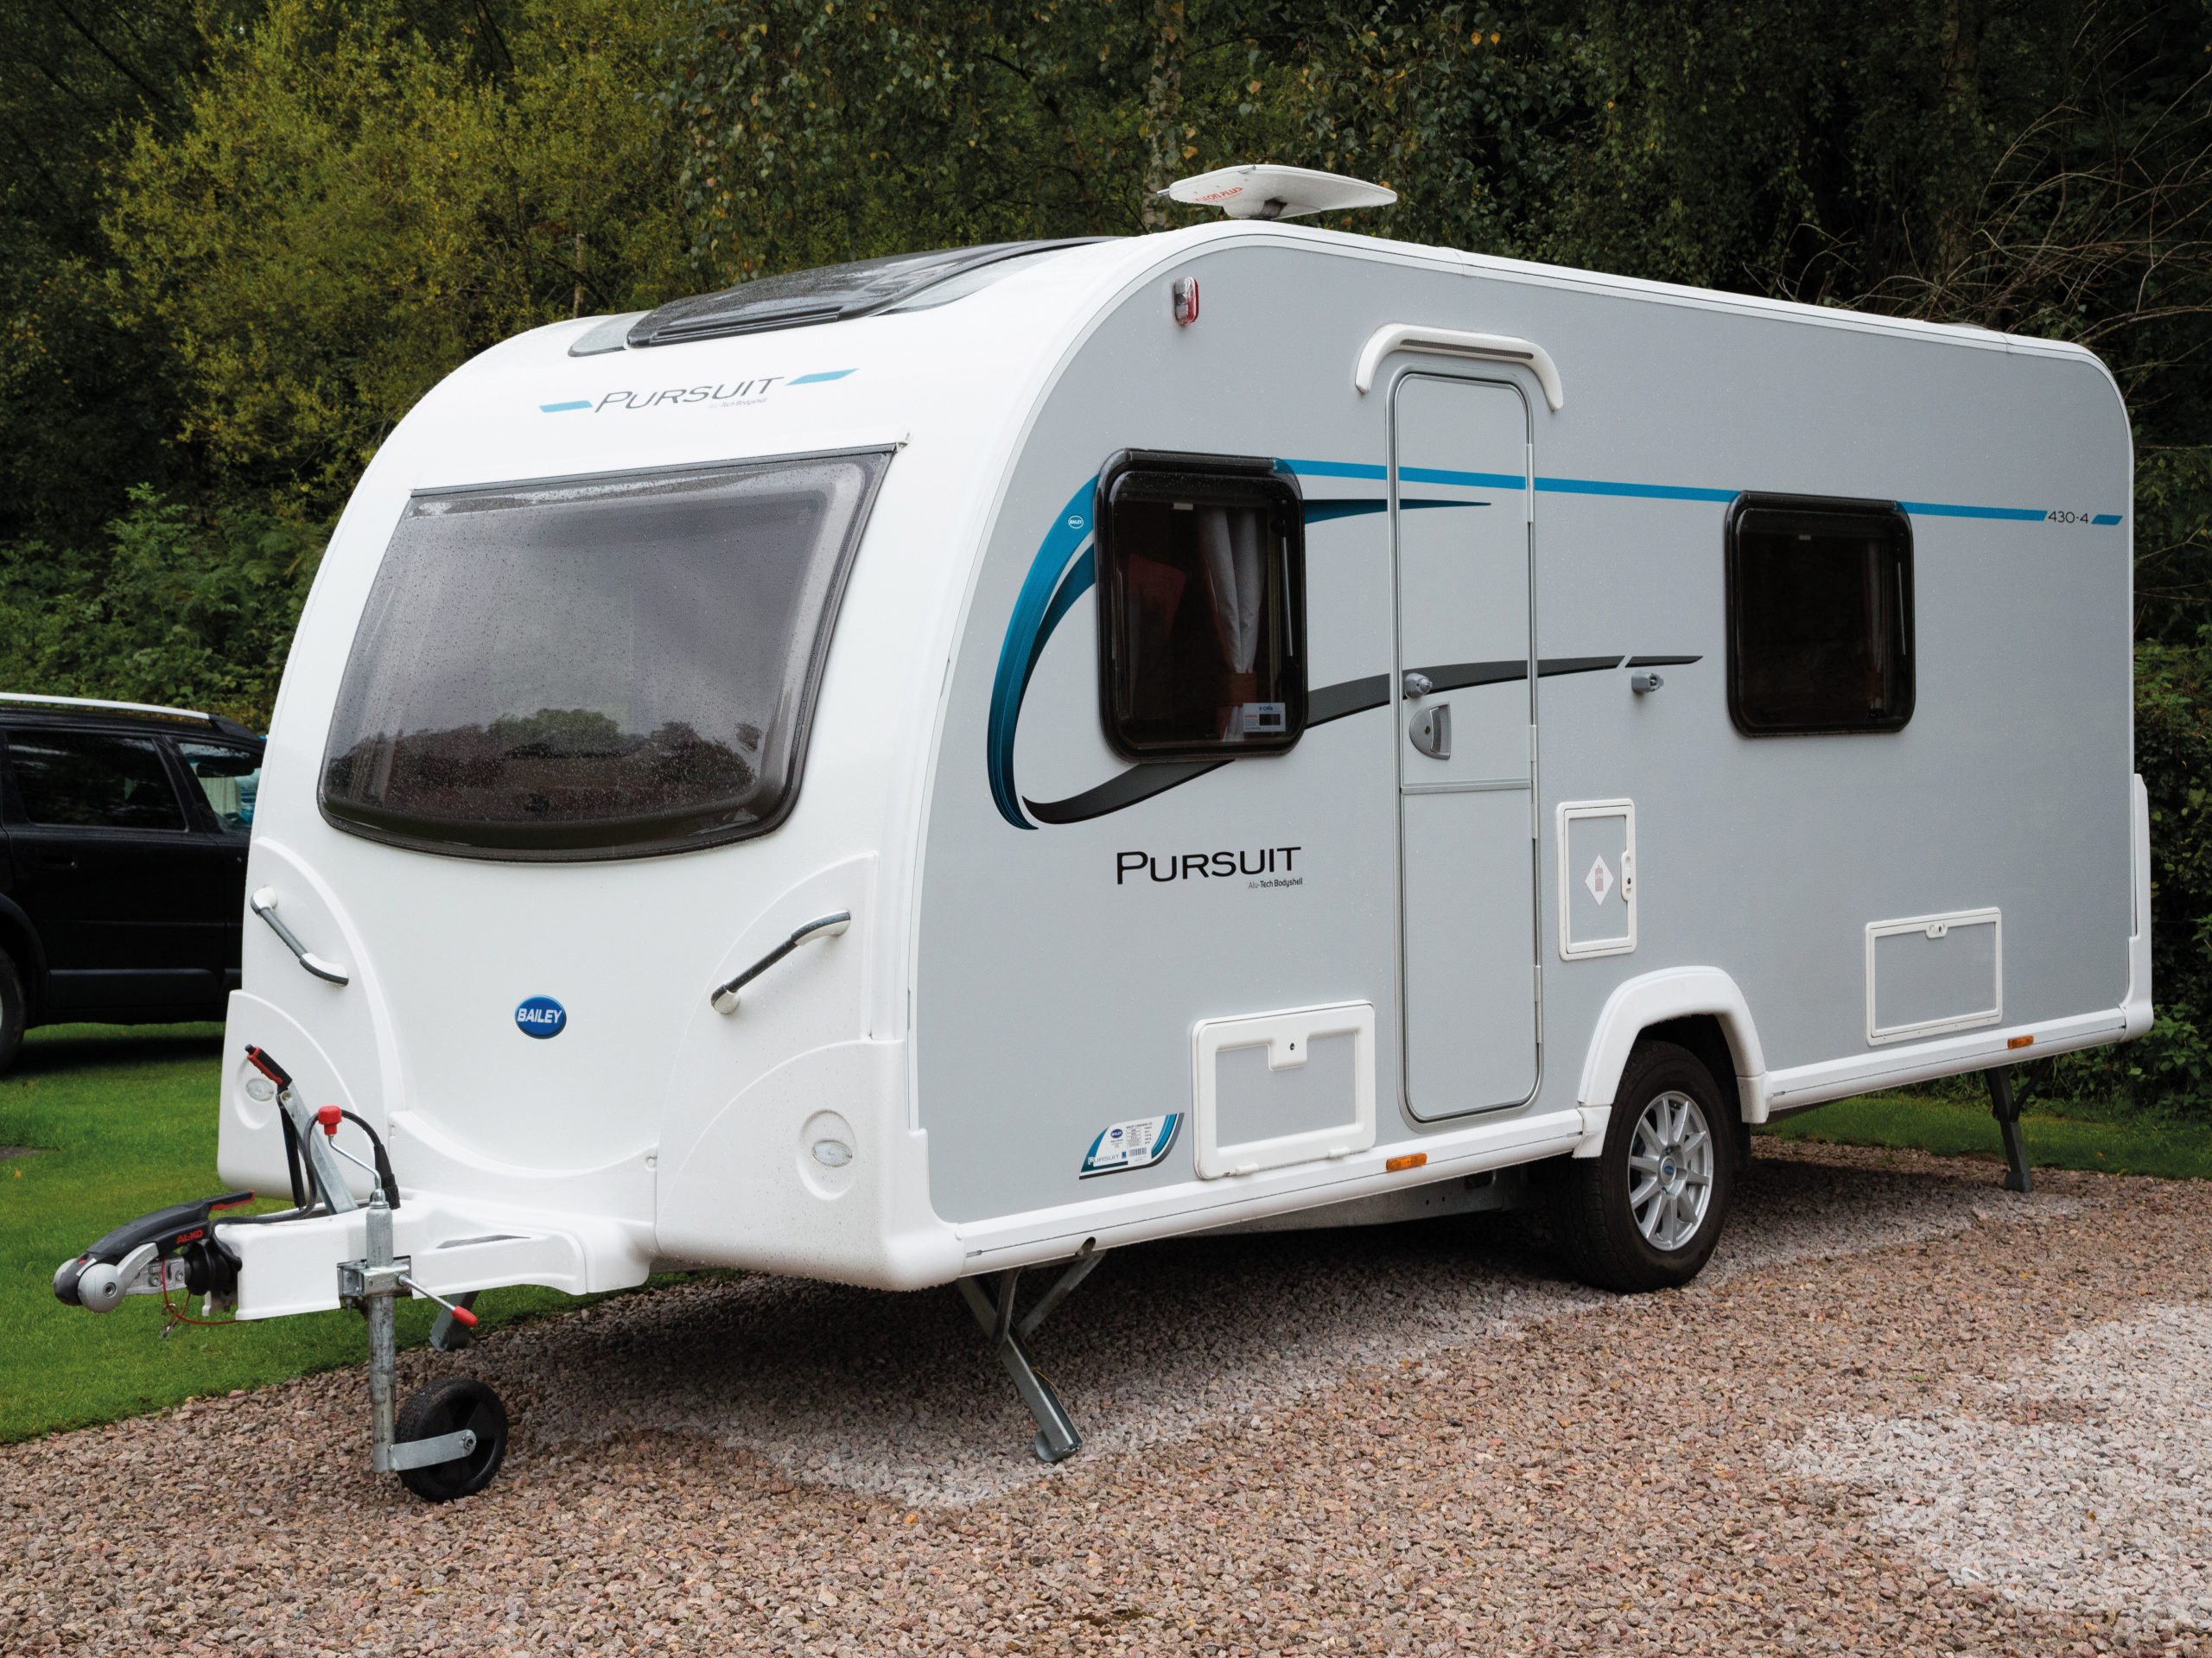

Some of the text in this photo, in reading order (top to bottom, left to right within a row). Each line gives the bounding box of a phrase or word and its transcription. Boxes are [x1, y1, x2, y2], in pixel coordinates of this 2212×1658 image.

[594, 377, 785, 413] PURSUIT
[1116, 847, 1301, 885] PURSUIT
[1274, 877, 1303, 887] Bodyshell
[517, 1007, 563, 1024] BAILEY
